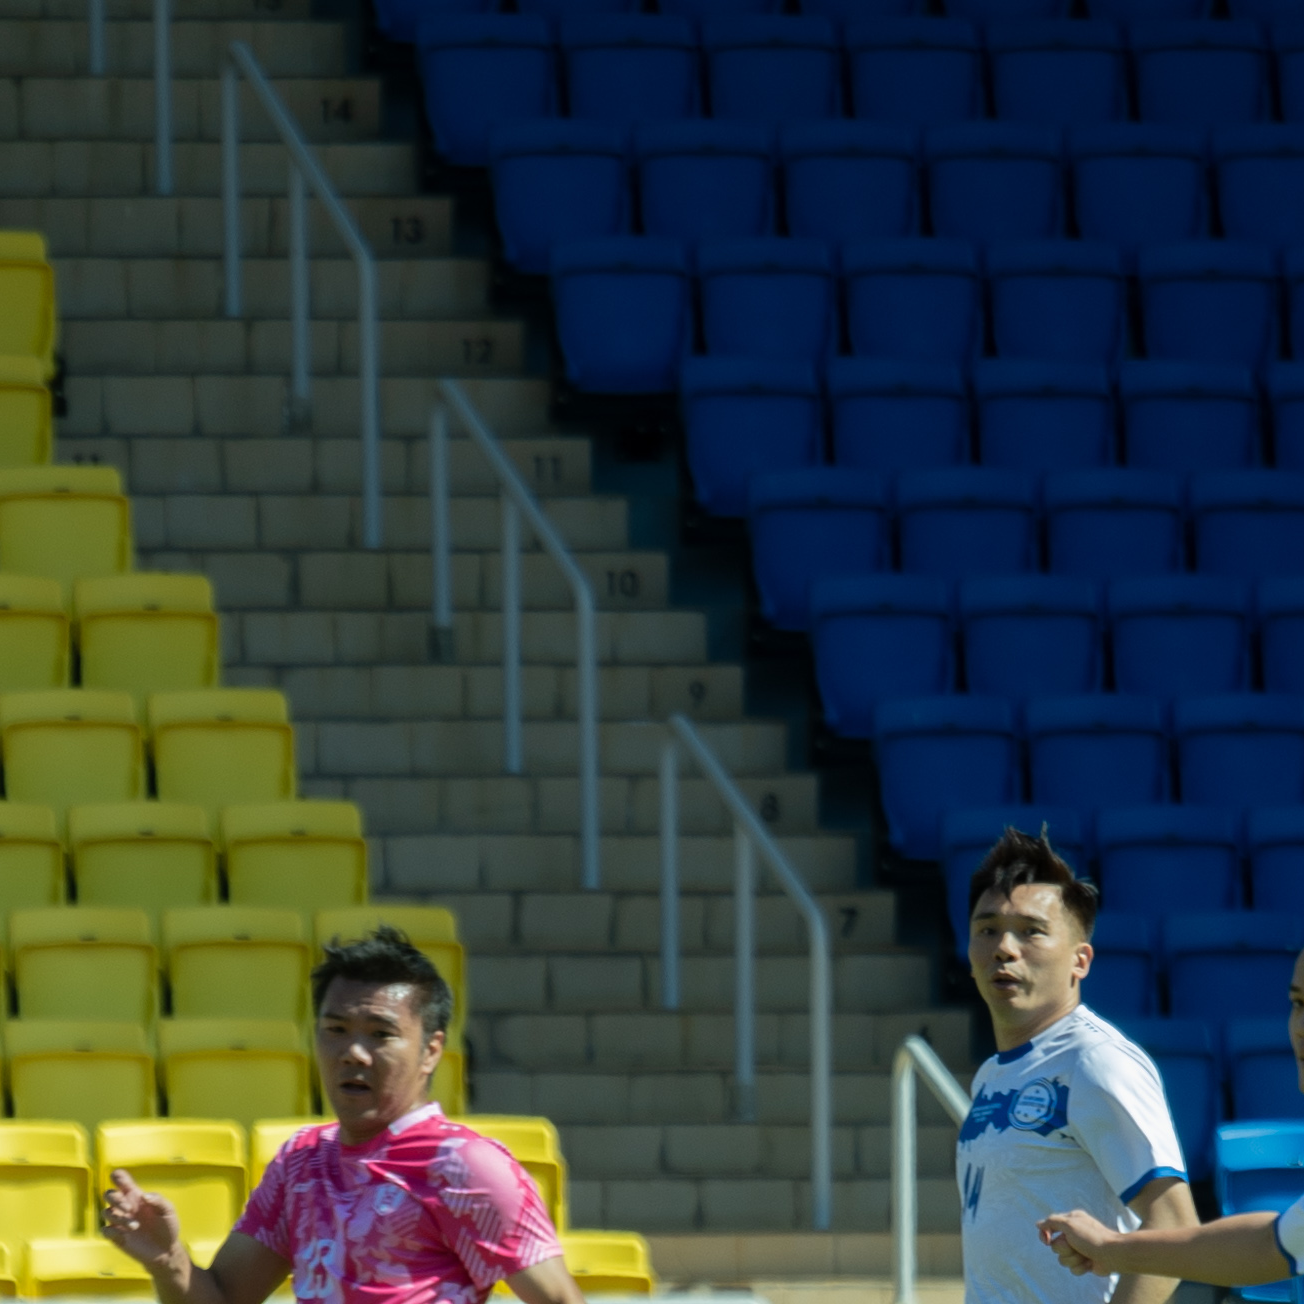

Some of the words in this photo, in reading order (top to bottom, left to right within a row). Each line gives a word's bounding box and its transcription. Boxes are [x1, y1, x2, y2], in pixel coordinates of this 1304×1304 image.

[391, 217, 426, 244] 13
[461, 338, 493, 365] 12
[533, 455, 562, 482] 11
[606, 569, 640, 597] 10
[759, 793, 780, 822] 8
[838, 906, 858, 937] 7
